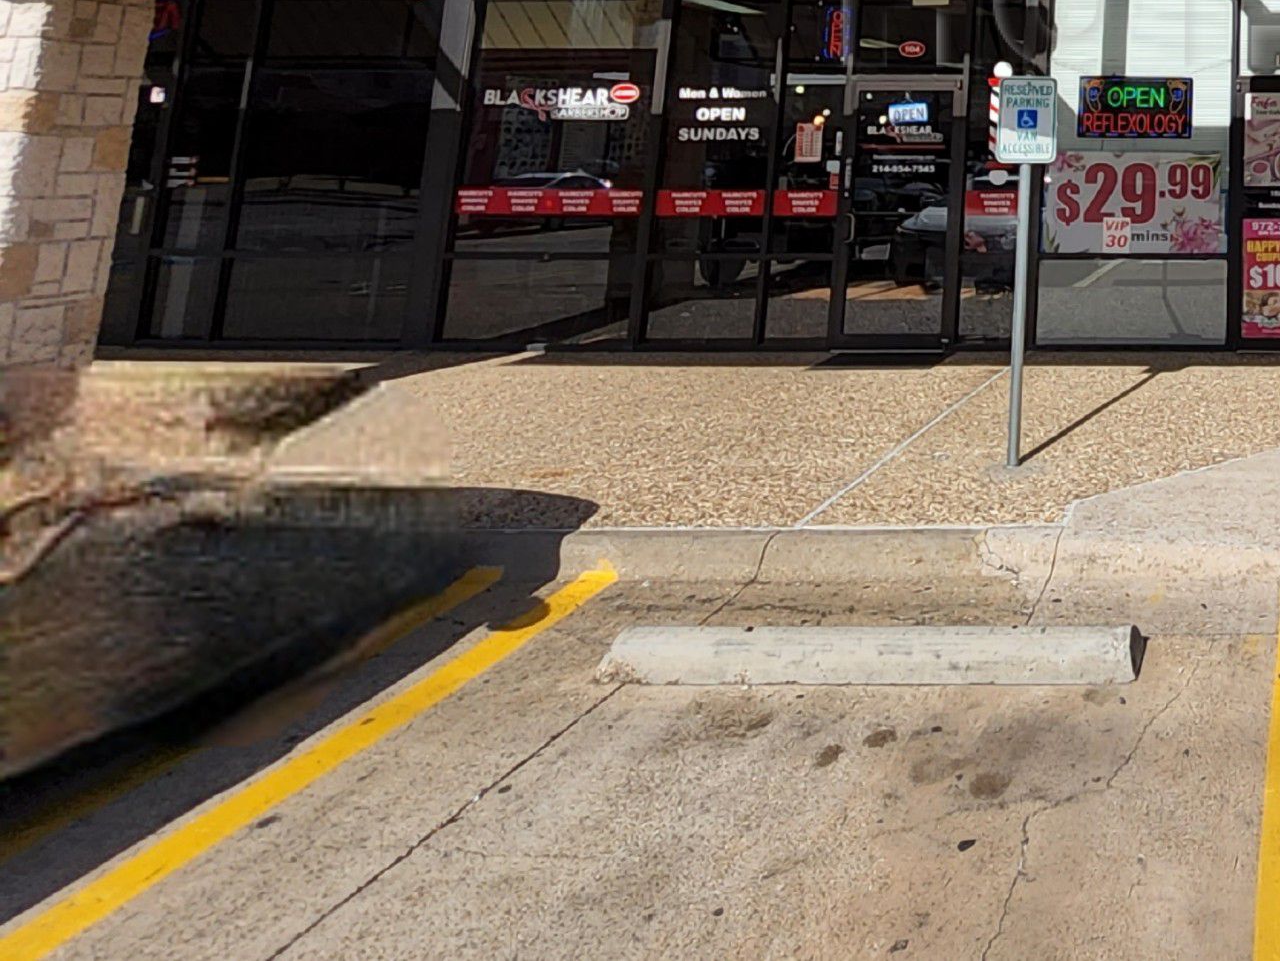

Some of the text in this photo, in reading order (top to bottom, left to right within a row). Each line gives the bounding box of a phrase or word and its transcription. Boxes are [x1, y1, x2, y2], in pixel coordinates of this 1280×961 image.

[483, 88, 610, 107] BLACKSHEAR
[679, 88, 767, 100] Men & Women
[1003, 85, 1053, 96] RESERVED
[1107, 86, 1165, 108] OPEN
[1006, 98, 1050, 109] PARKING
[696, 107, 746, 122] OPEN
[893, 108, 925, 122] OPEN
[1082, 113, 1186, 134] REFLEXOLOGY
[678, 127, 760, 141] SUNDAYS
[1016, 130, 1038, 142] VAN
[1002, 143, 1050, 154] ACCESSIBLE
[1056, 162, 1212, 227] $29.99
[1105, 221, 1130, 231] VIP
[1106, 230, 1169, 248] 30 mins
